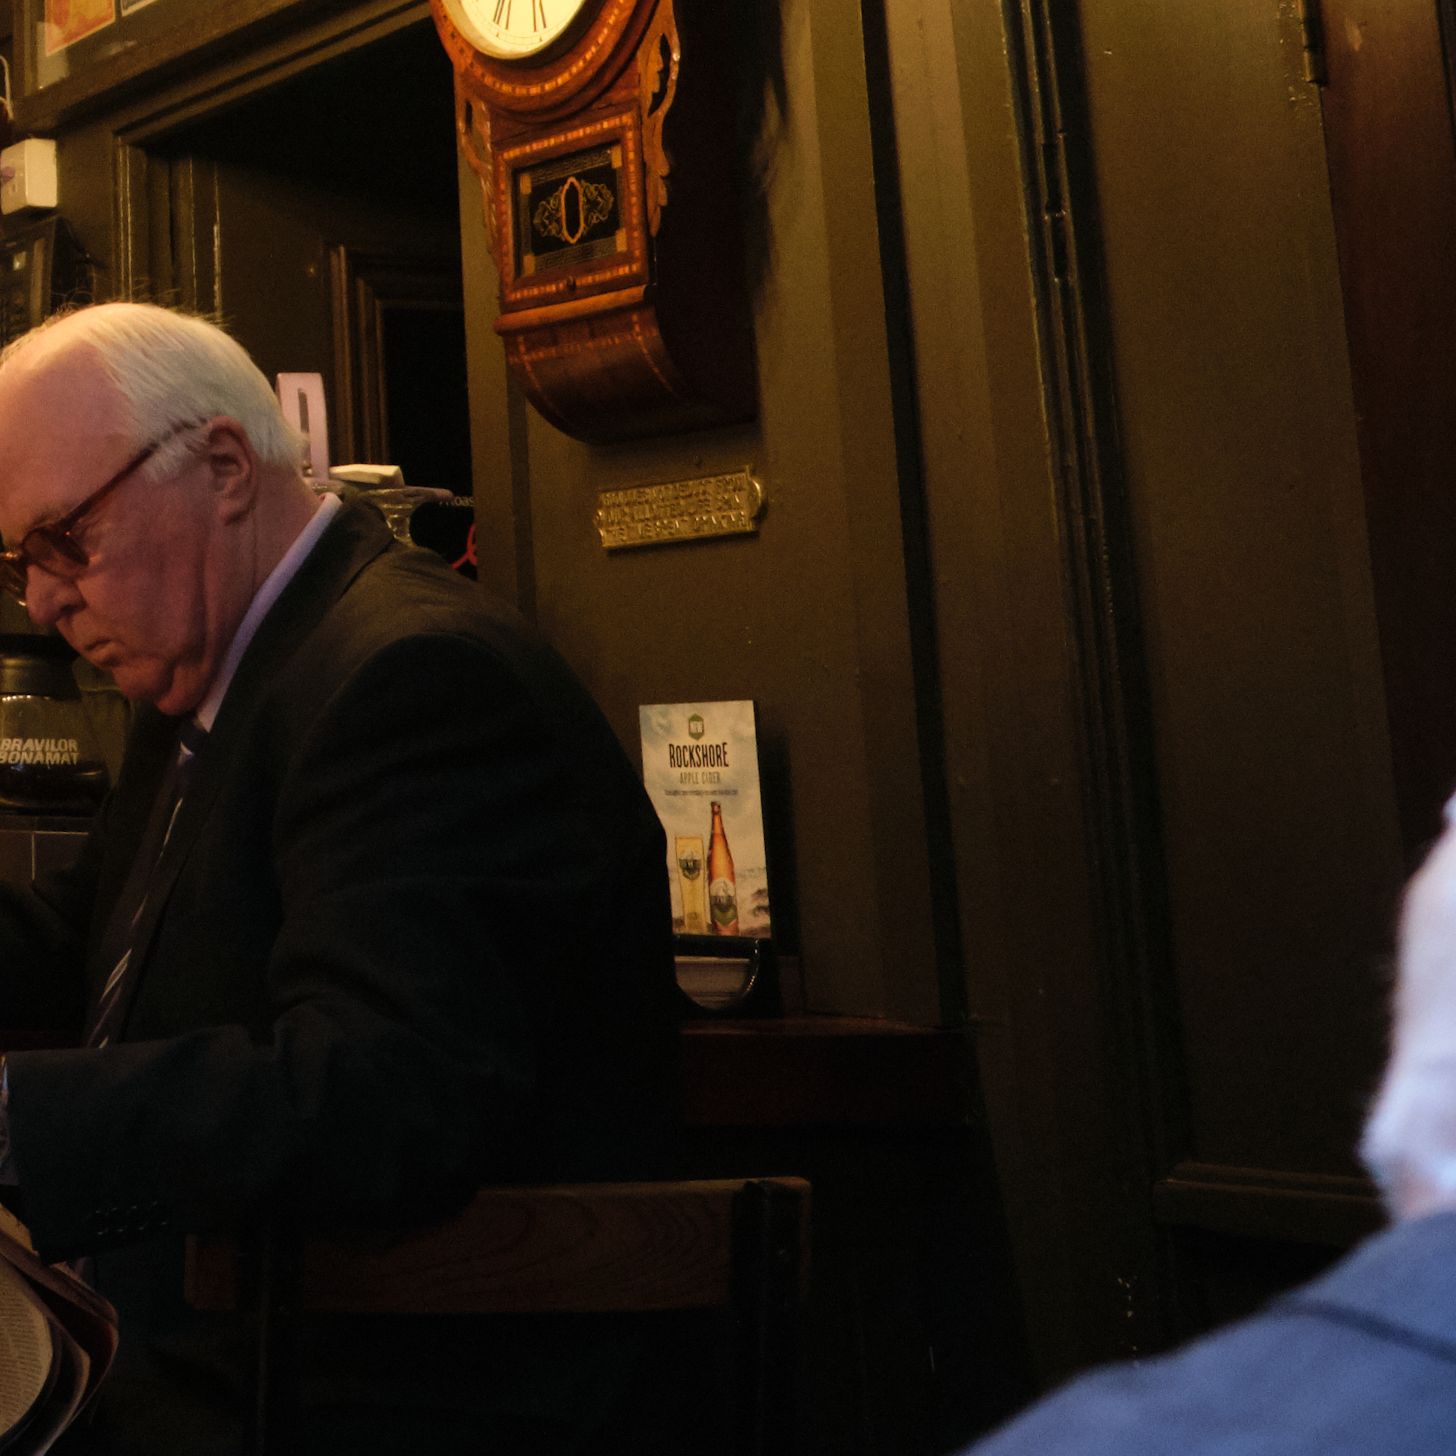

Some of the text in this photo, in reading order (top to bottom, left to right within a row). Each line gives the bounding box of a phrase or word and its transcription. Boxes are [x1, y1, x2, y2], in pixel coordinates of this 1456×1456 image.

[0, 738, 78, 752] BRAVILOR
[669, 742, 729, 768] ROCKSHORE
[680, 772, 720, 784] APPLE CIDER
